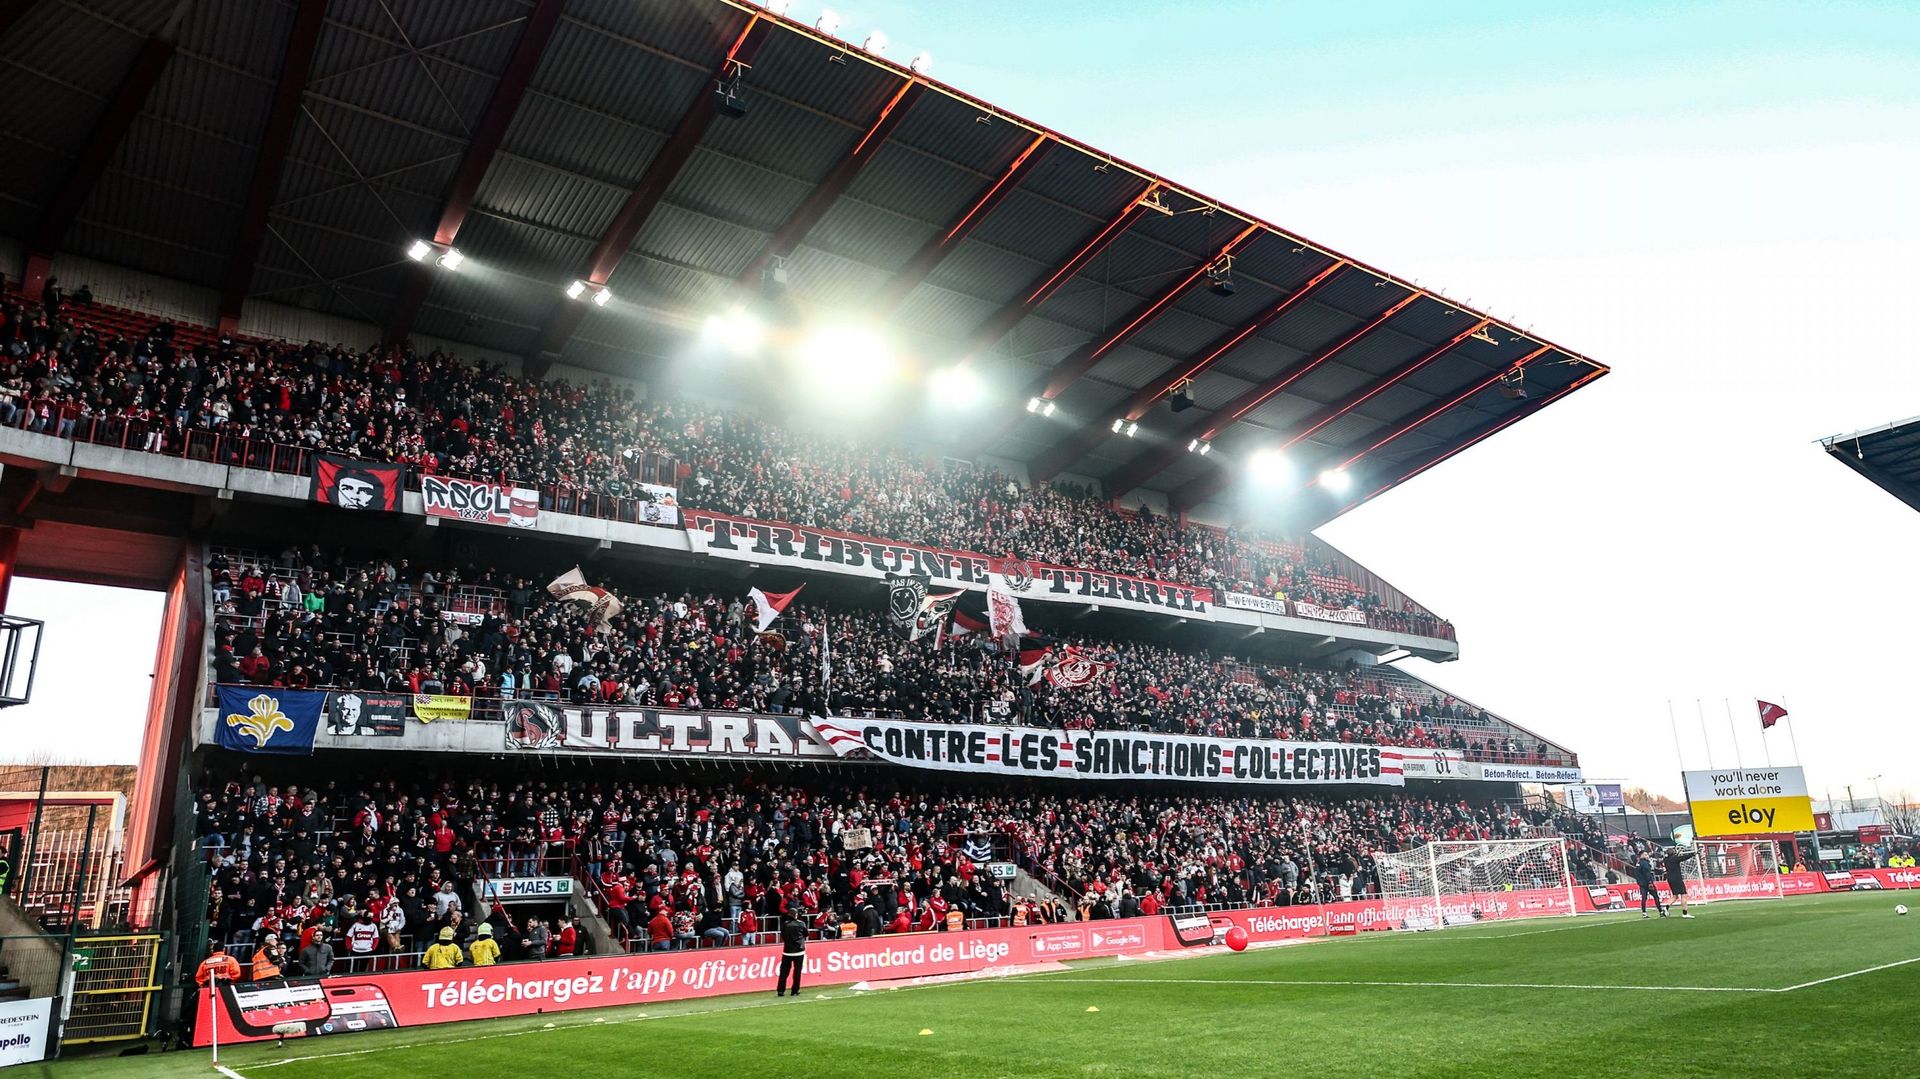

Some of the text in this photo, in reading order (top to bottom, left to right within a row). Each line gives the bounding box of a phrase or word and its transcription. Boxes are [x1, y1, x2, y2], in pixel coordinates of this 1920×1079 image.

[423, 477, 511, 515] RSCL
[696, 516, 990, 585] TRIBUNE
[863, 726, 1381, 780] CONTRE LES SANCTIONS COLLECTIVES
[1711, 771, 1779, 786] you'll never
[1715, 784, 1782, 796] work alone
[1728, 803, 1776, 828] eloy
[513, 881, 552, 894] MAES
[1248, 915, 1323, 933] Téléchargez
[1406, 904, 1420, 918] du
[1047, 941, 1082, 951] App Store
[1106, 935, 1141, 946] Google Play
[421, 975, 604, 1009] Téléchargez
[827, 945, 925, 972] Standard
[929, 943, 954, 963] de
[959, 939, 1009, 962] Liège
